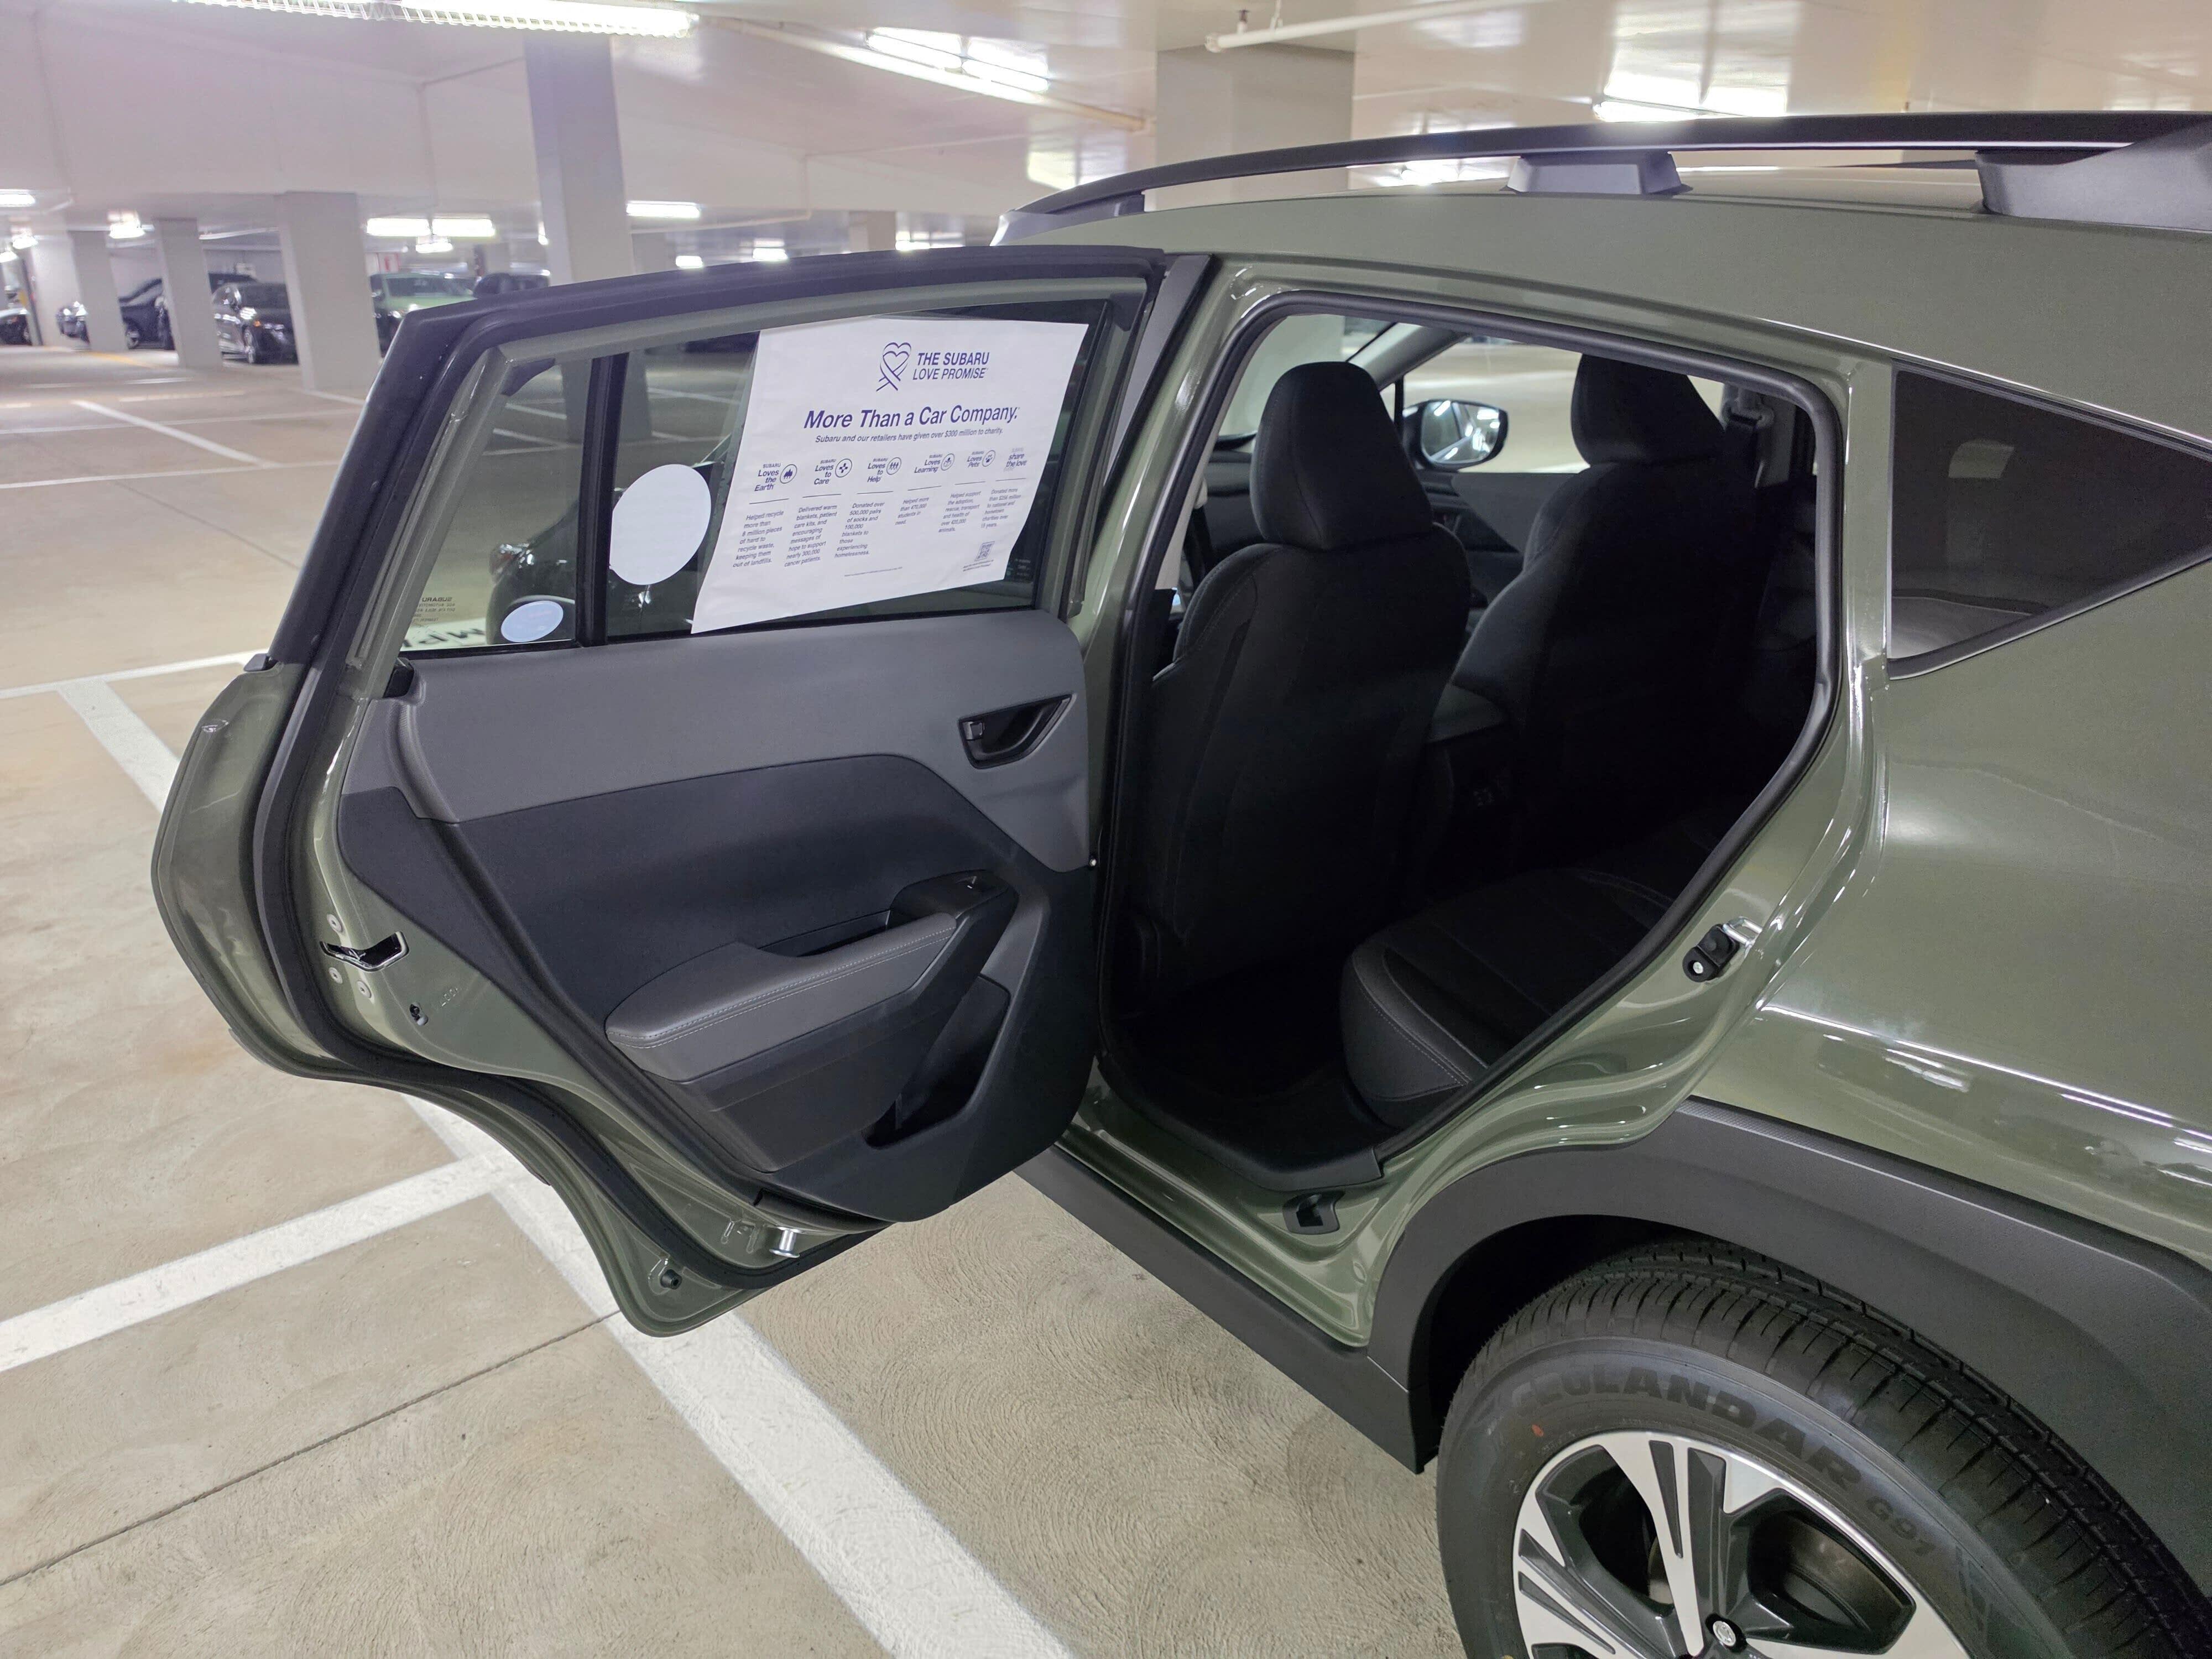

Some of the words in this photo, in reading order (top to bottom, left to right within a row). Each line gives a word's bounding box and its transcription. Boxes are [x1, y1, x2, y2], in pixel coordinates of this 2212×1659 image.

[917, 352, 940, 366] THE
[943, 352, 989, 366] SUBARU
[912, 368, 940, 380] LOVE
[941, 368, 987, 379] PROMISE
[804, 410, 853, 429] More
[860, 409, 900, 427] Than
[904, 412, 914, 426] a
[919, 406, 947, 425] Car
[950, 405, 1018, 425] Company.
[913, 432, 930, 441] given
[984, 427, 1003, 435] charity.
[792, 528, 823, 537] encouraging
